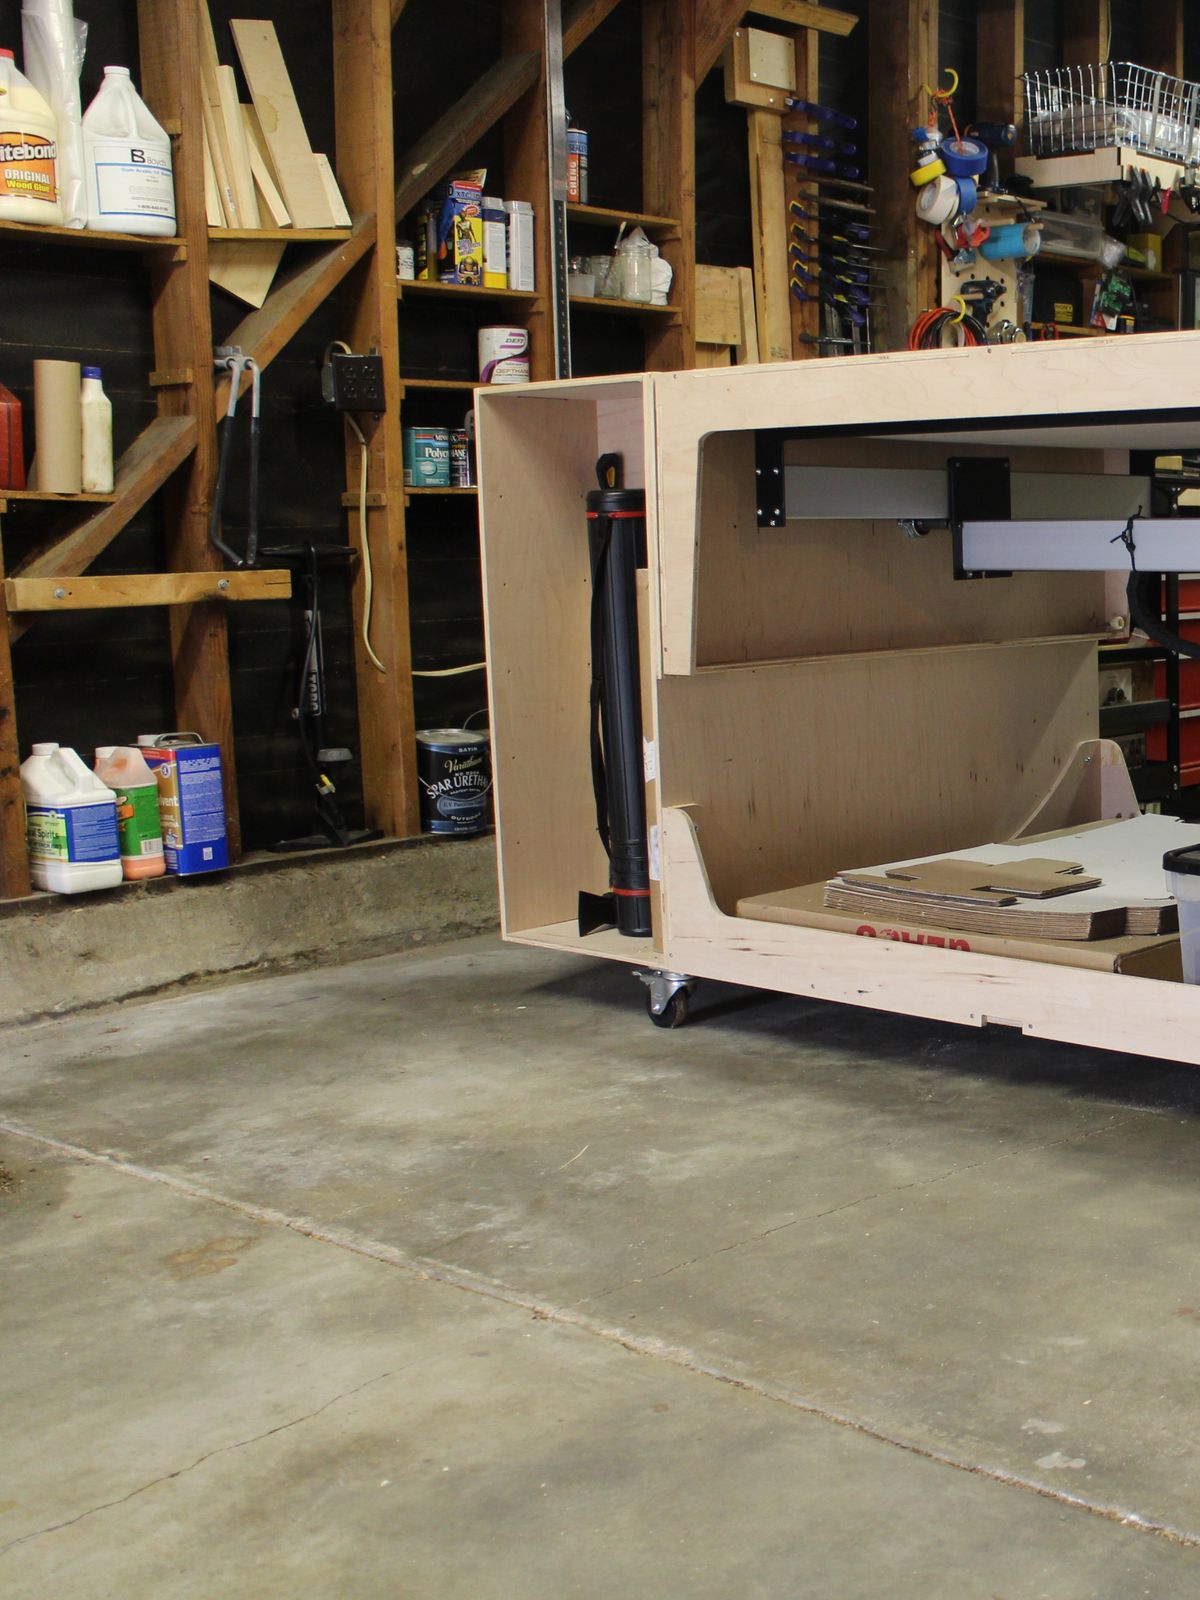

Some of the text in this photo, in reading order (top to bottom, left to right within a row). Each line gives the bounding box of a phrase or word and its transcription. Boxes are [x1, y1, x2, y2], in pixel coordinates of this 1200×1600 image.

[0, 143, 57, 161] itebond
[4, 168, 51, 184] ORIGINAL
[569, 161, 577, 196] CHENG
[6, 179, 51, 193] Wood Glue
[505, 337, 525, 345] DEFT
[426, 774, 487, 799] SPAR URETHA
